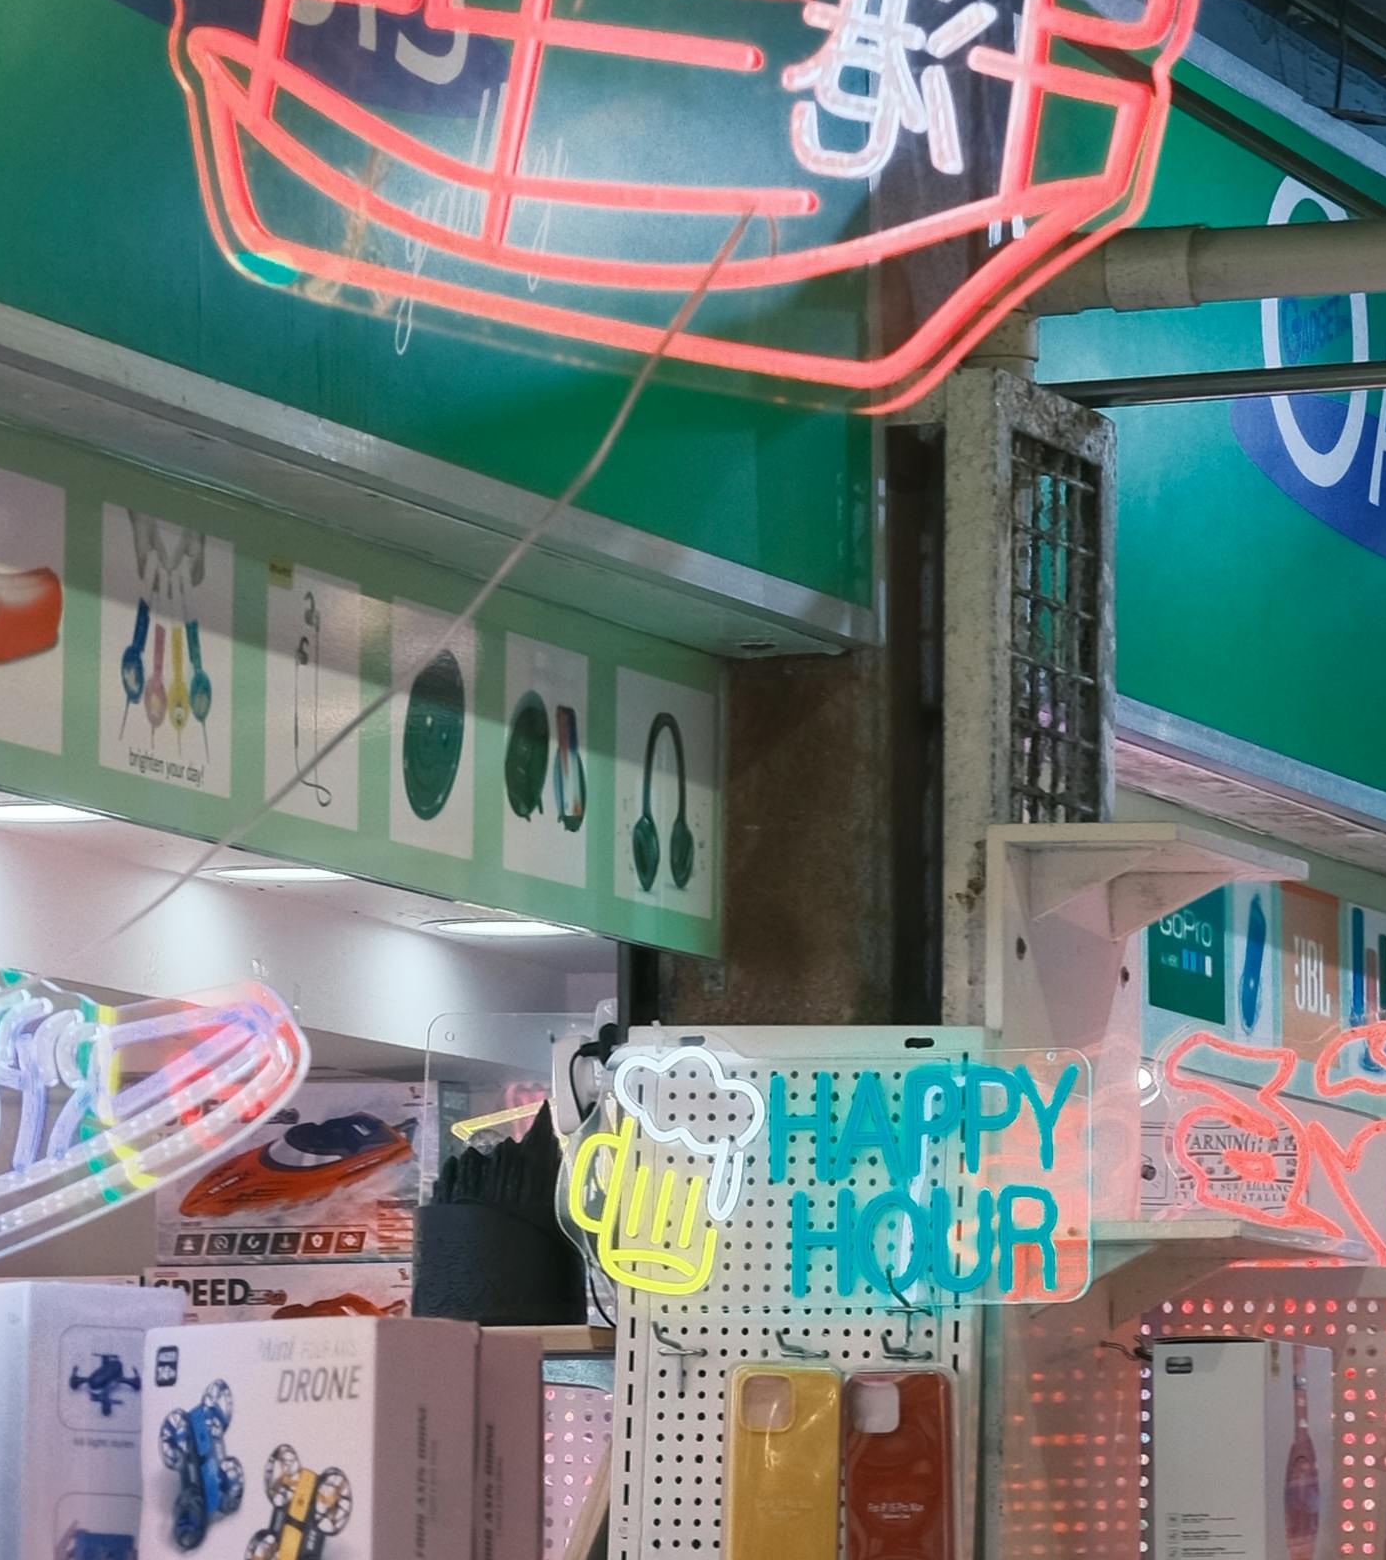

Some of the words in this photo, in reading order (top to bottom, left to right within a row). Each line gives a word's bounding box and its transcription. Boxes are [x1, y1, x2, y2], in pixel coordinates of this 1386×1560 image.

[767, 1063, 1080, 1183] HAPPY
[791, 1184, 1059, 1298] HOUR
[277, 1365, 362, 1404] DRONE
